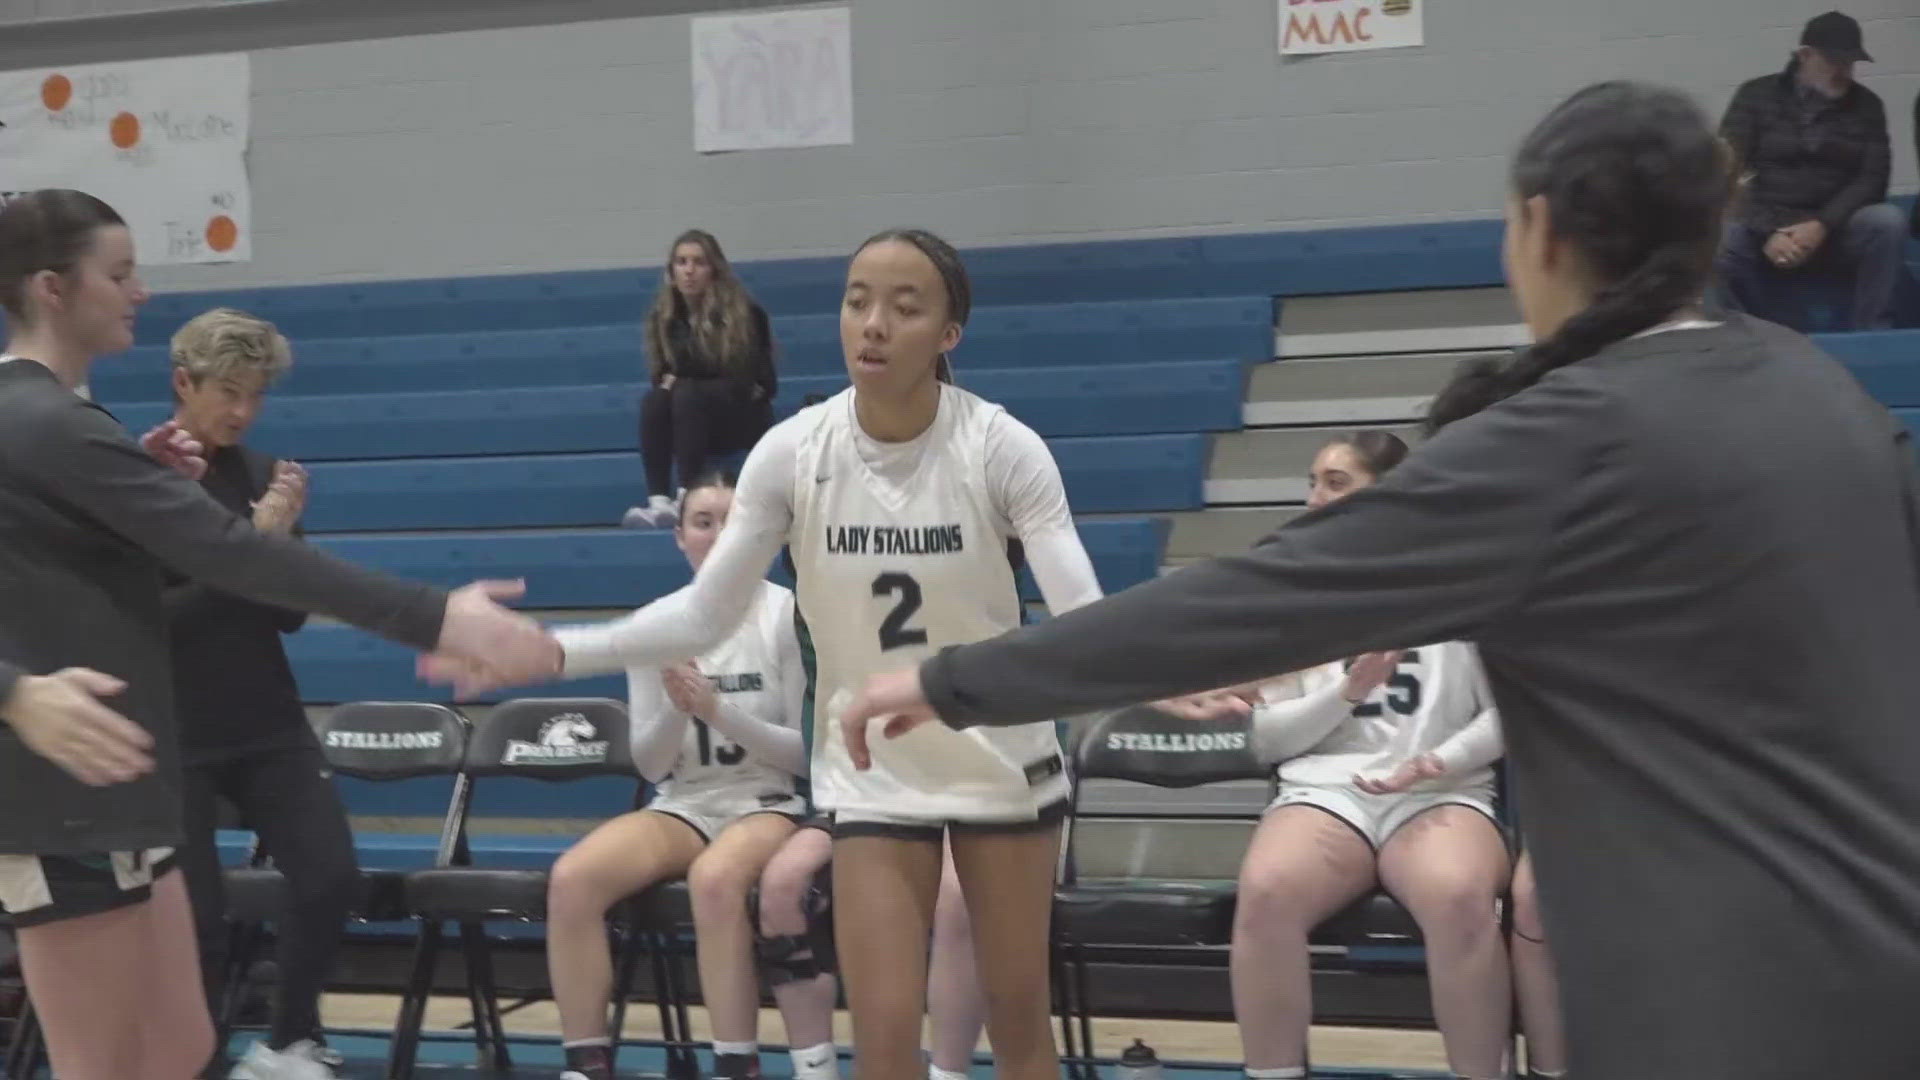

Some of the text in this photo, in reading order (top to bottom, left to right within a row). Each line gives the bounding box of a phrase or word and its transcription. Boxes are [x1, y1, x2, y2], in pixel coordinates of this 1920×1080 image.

[1283, 8, 1373, 48] MAC
[826, 524, 963, 555] LADY STALLIONS
[871, 572, 928, 652] 2
[326, 731, 443, 749] STALLIONS
[1107, 732, 1246, 751] STALLIONS
